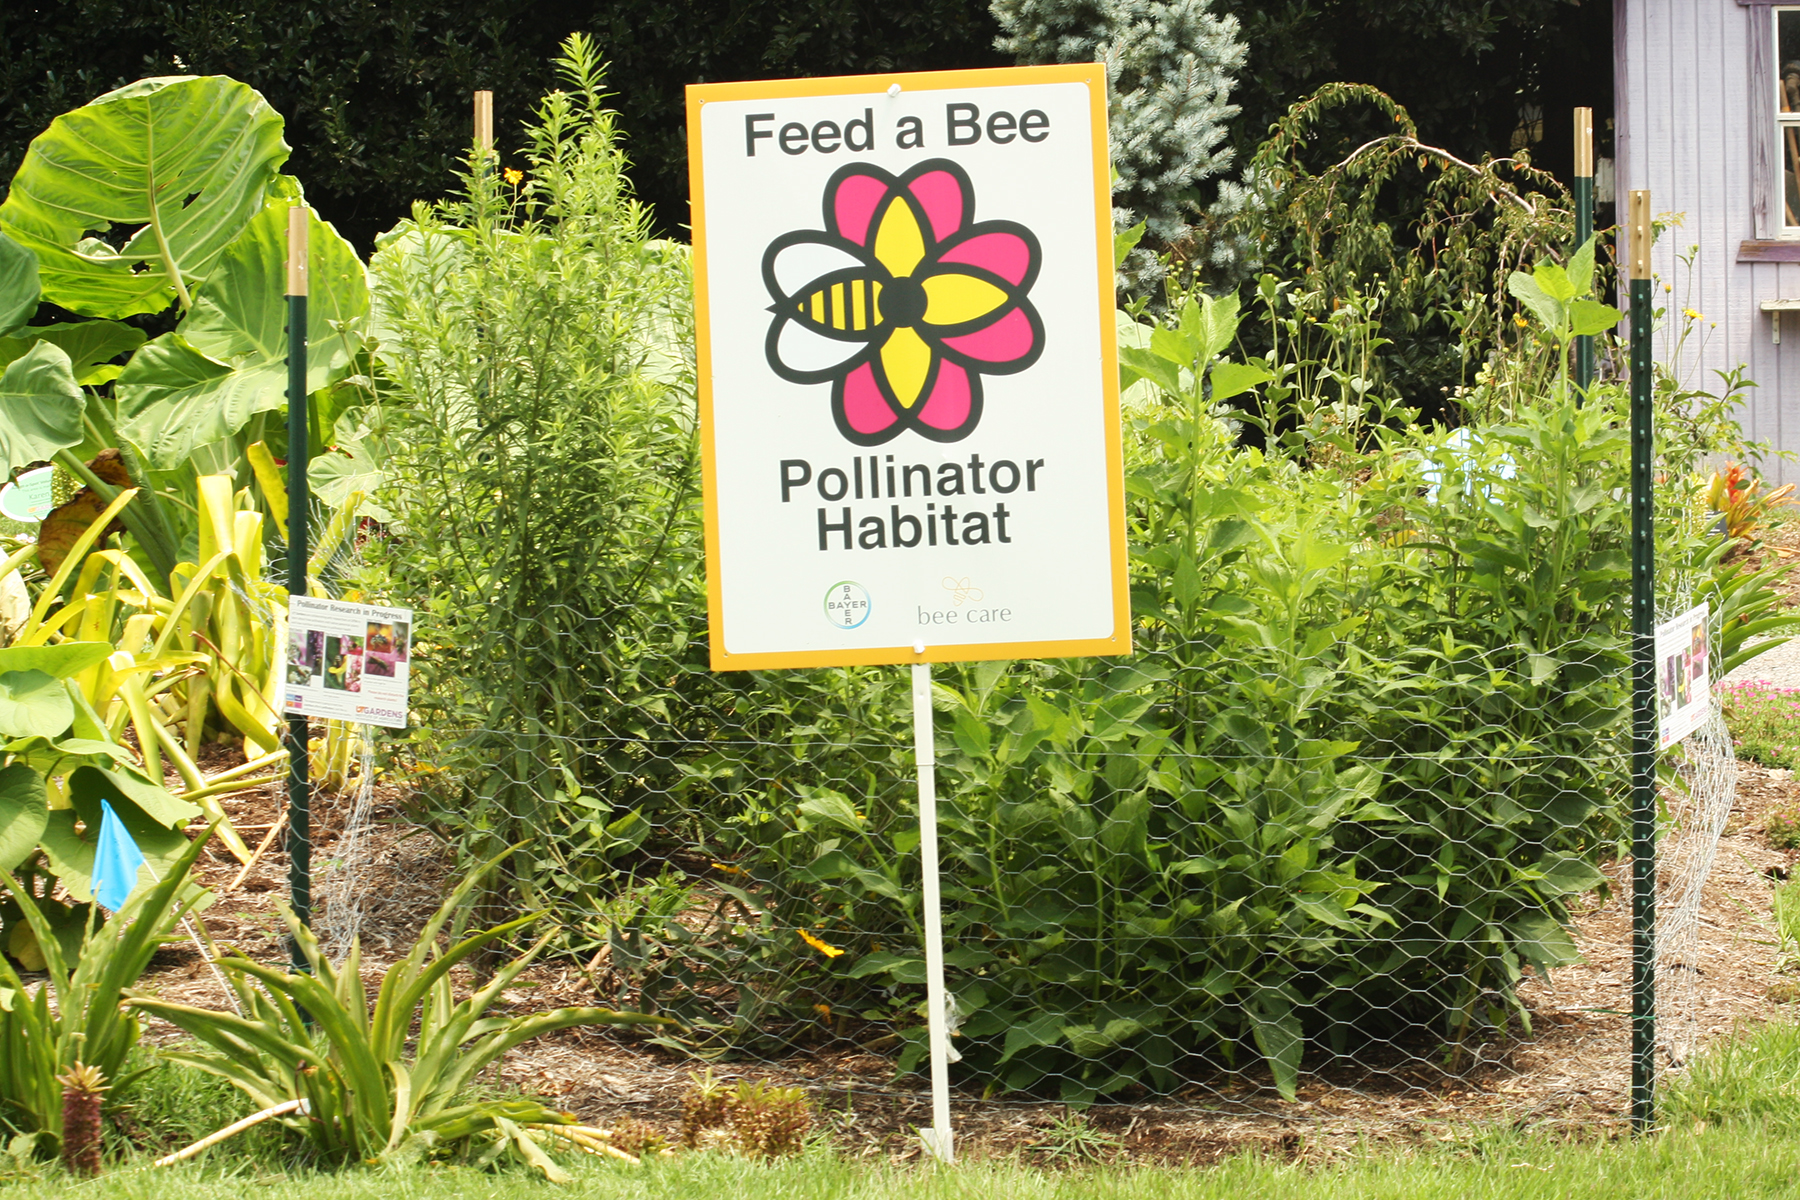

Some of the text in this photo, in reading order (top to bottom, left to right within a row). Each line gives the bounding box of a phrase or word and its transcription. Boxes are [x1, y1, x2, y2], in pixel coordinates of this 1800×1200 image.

[746, 102, 1050, 157] Feed a Bee
[780, 454, 1045, 503] Pollinator
[817, 503, 1012, 551] Habitat
[297, 600, 403, 620] Pollinator Research in Progress
[828, 600, 867, 610] BAYER
[917, 605, 1012, 626] bee care
[364, 707, 403, 719] GARDENS
